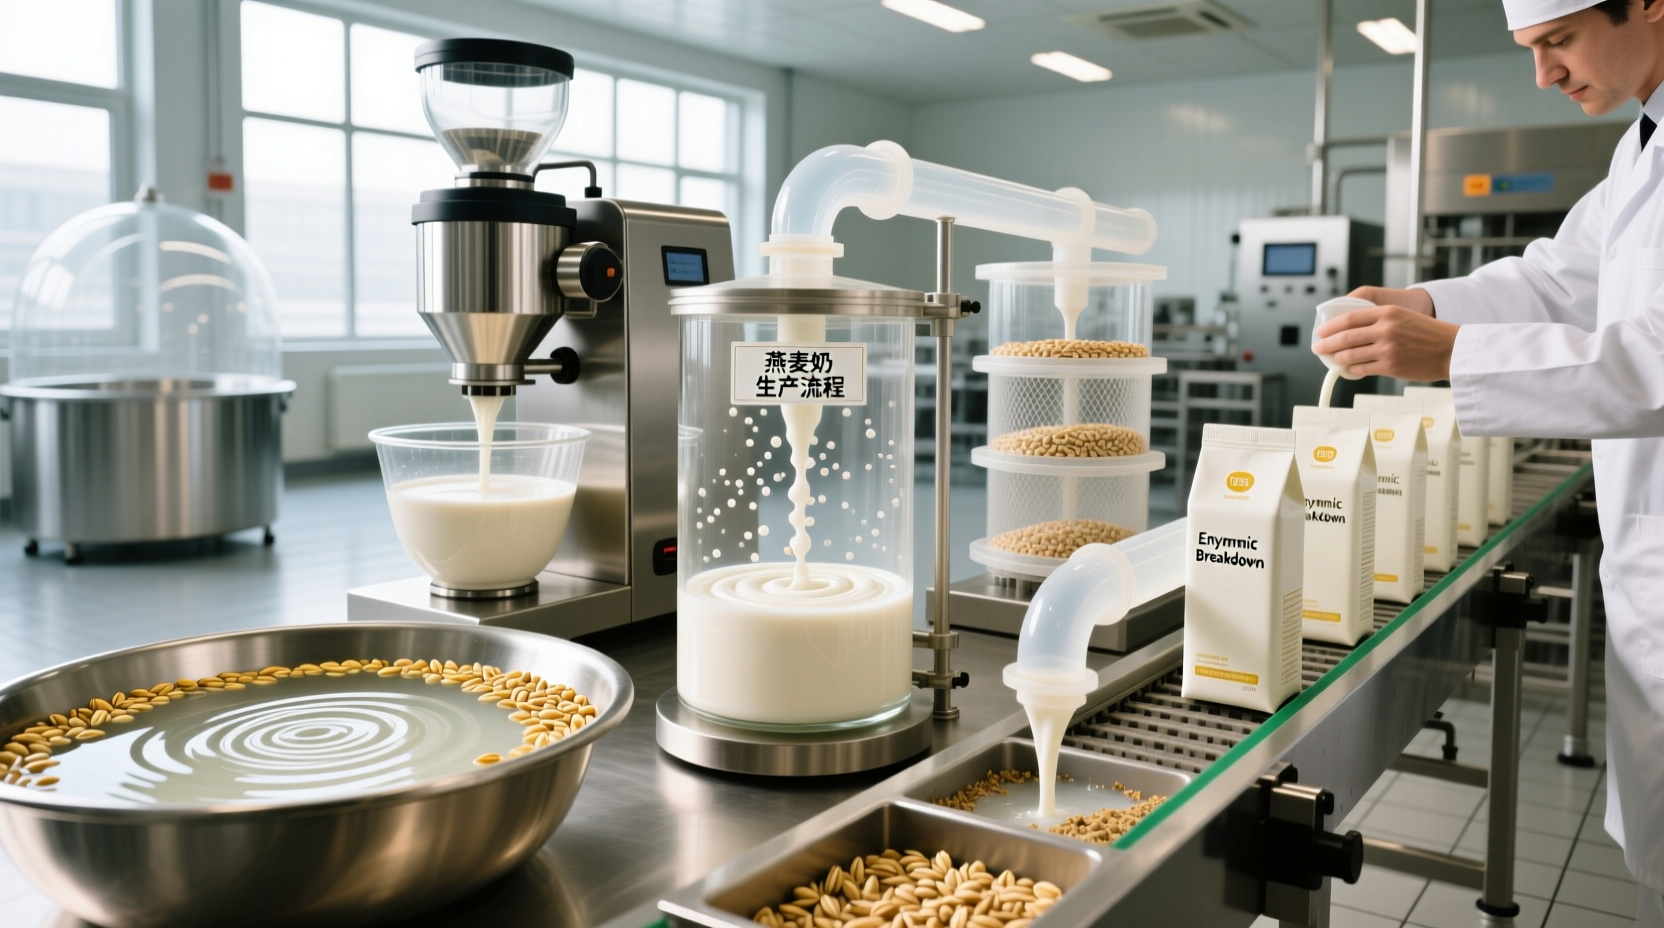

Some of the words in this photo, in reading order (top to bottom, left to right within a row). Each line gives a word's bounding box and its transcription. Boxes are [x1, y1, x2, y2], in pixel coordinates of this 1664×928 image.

[764, 350, 833, 374] 燕麦奶
[755, 374, 846, 399] 生产流程
